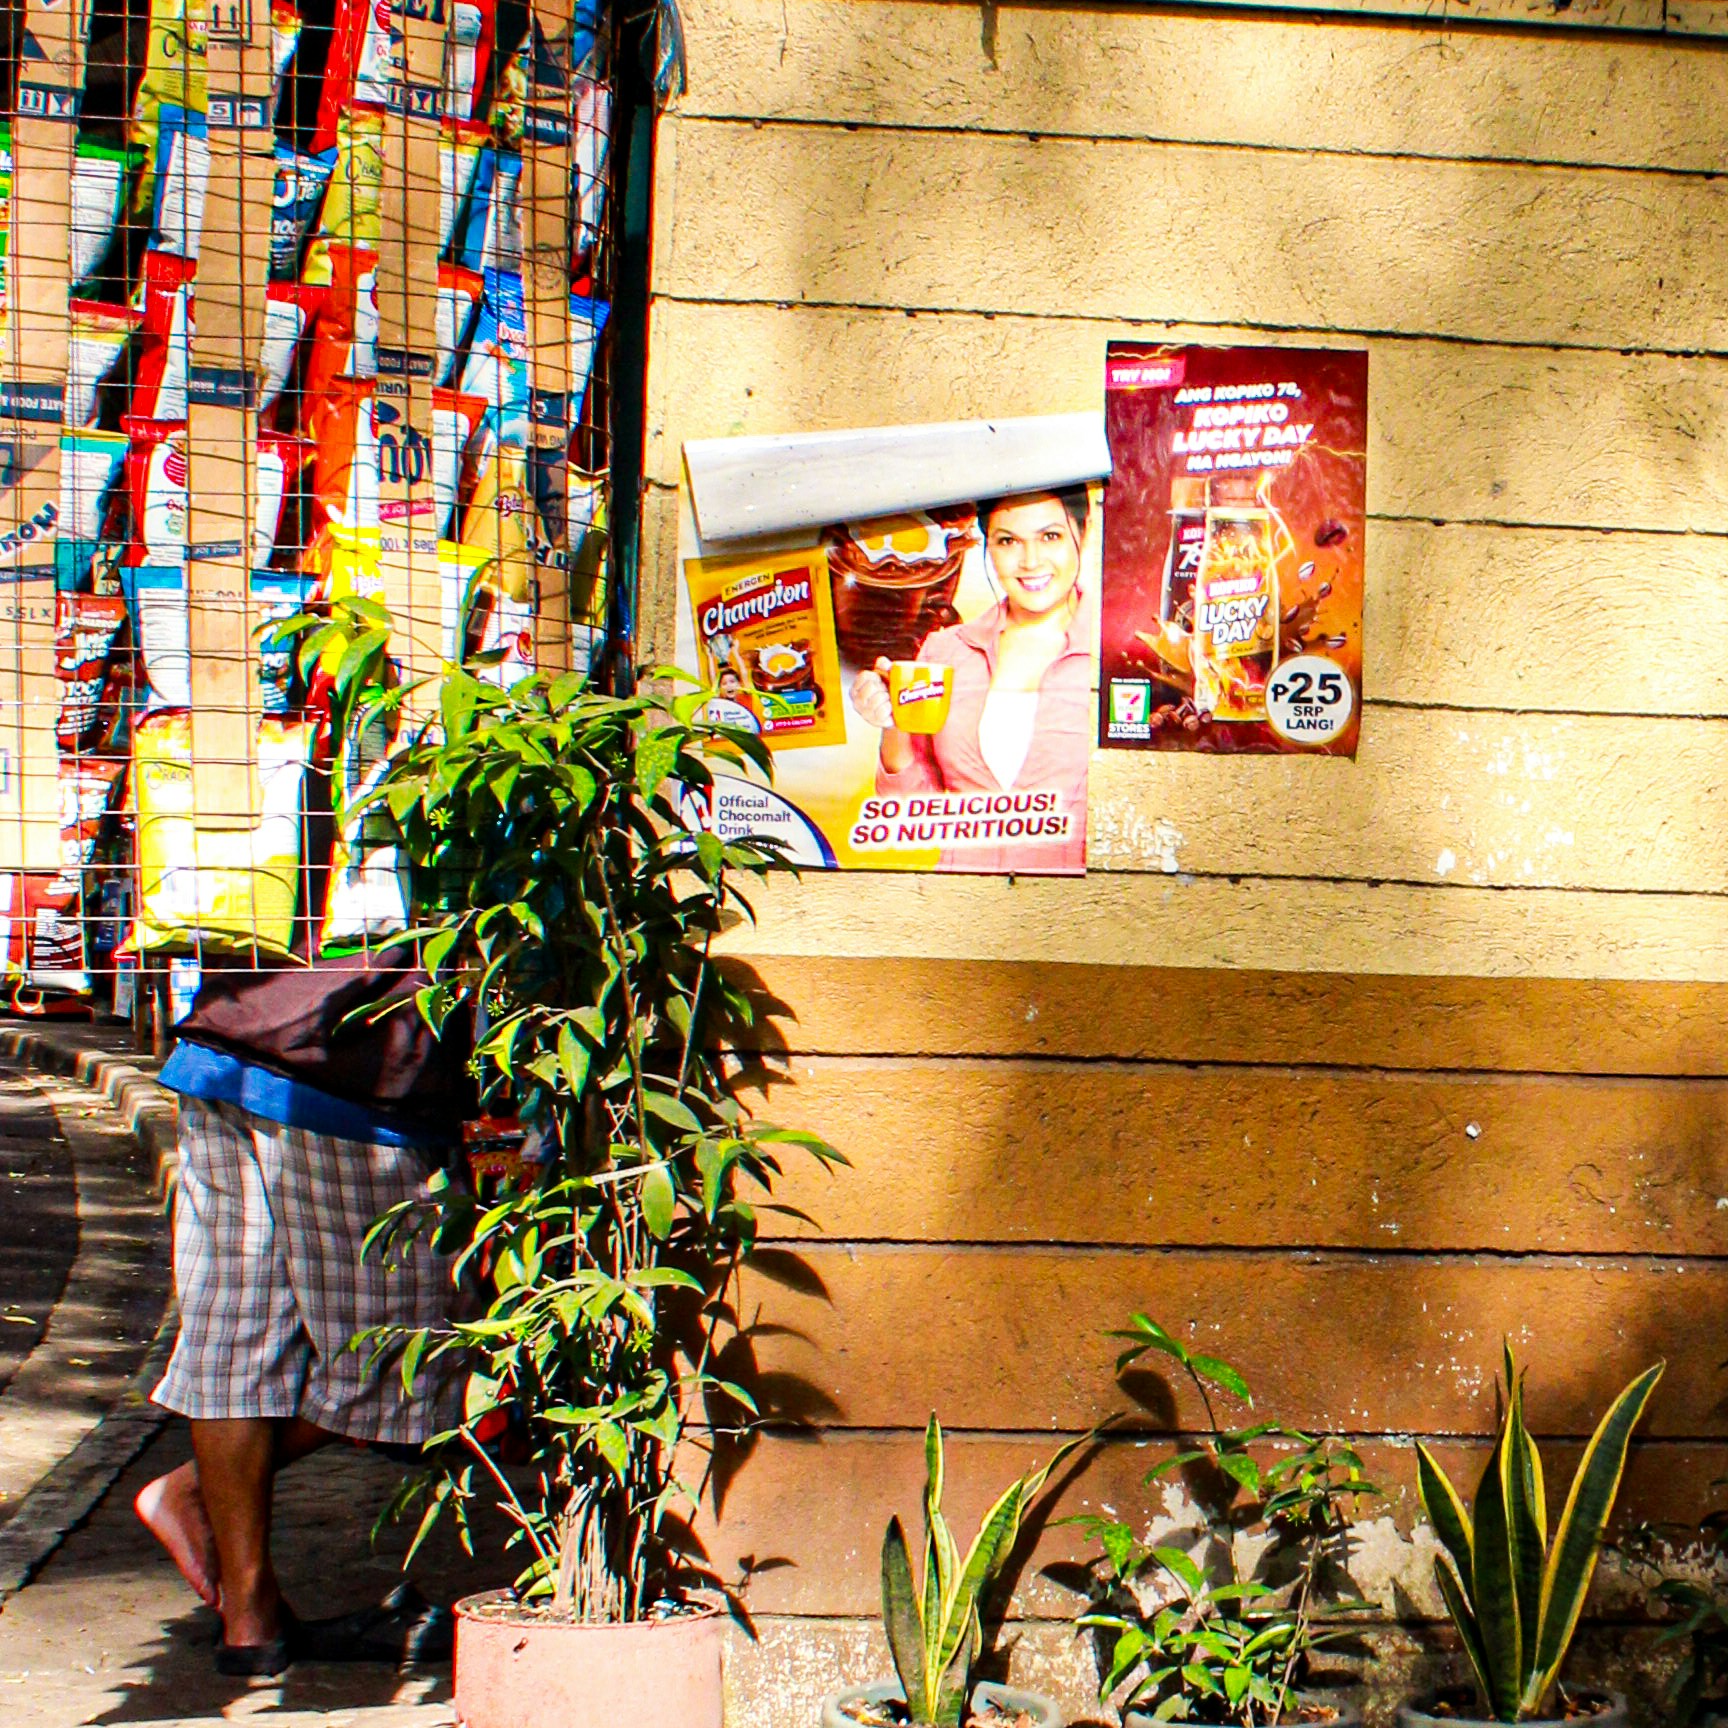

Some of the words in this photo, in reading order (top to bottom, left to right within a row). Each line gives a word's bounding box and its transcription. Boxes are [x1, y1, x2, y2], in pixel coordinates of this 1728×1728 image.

[1174, 387, 1212, 404] ANG
[1214, 383, 1275, 400] KOPIKO
[1277, 382, 1302, 399] 78,
[1193, 403, 1289, 428] KOPIKO
[1172, 427, 1262, 453] LUCKY
[1263, 424, 1315, 446] DAY
[1186, 454, 1213, 471] NA
[1215, 450, 1292, 470] NGAYON!
[725, 573, 770, 596] ENERGEN
[703, 579, 809, 636] Champion
[1200, 595, 1268, 631] LUCKY
[1212, 619, 1257, 645] DAY
[1293, 706, 1324, 716] SRP
[1286, 719, 1334, 730] LANG!
[719, 796, 769, 808] Official
[863, 800, 901, 819] SO
[908, 793, 1056, 817] DELICIOUS!
[719, 809, 792, 822] Chocomalt
[719, 824, 754, 835] Drink
[853, 825, 890, 844] SO
[897, 816, 1068, 842] NUTRITIOUS!
